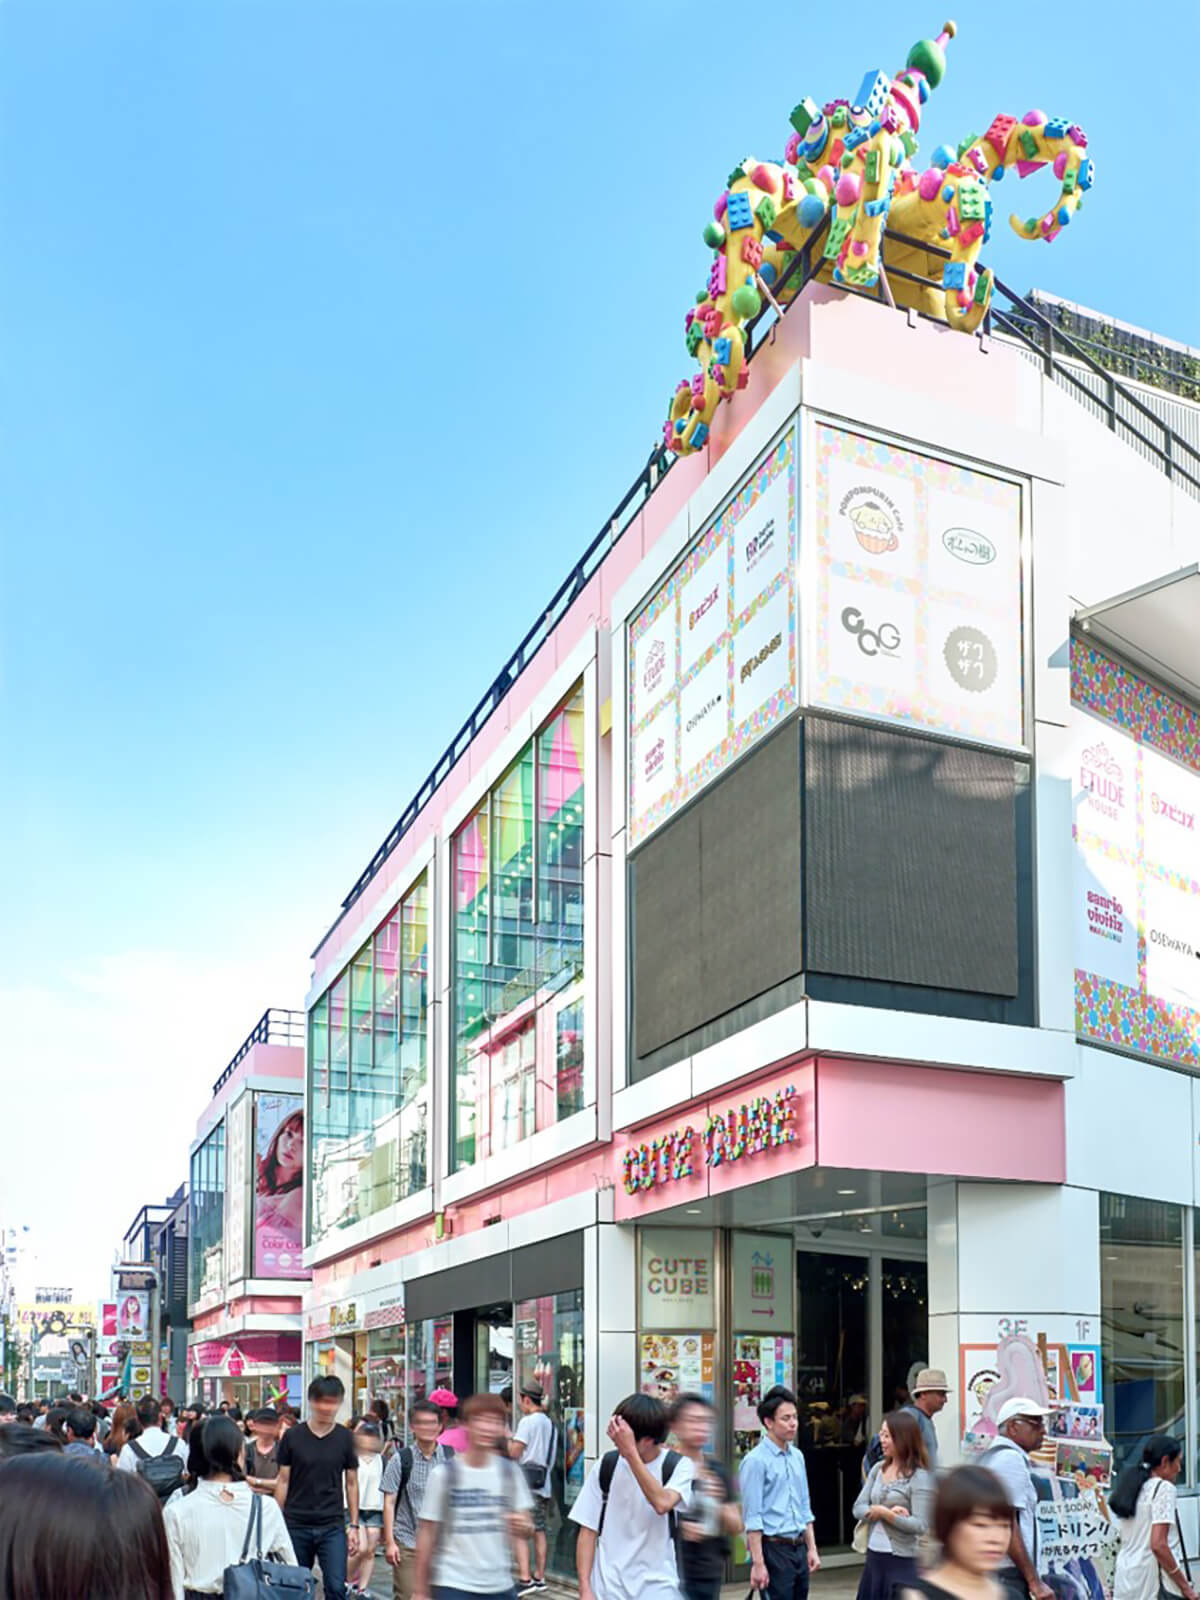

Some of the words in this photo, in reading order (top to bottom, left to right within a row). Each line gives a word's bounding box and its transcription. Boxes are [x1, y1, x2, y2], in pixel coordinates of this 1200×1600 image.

[1080, 766, 1125, 808] ETUDE
[1088, 799, 1119, 821] HOUSE
[1160, 800, 1196, 832] スピンズ
[1087, 890, 1124, 915] sanrio
[1149, 929, 1194, 956] OSEWAYA
[622, 1125, 694, 1195] CUTE
[702, 1084, 797, 1168] CUBE
[648, 1258, 707, 1275] CUTE
[648, 1278, 708, 1294] CUBE
[1075, 1320, 1091, 1341] 1F
